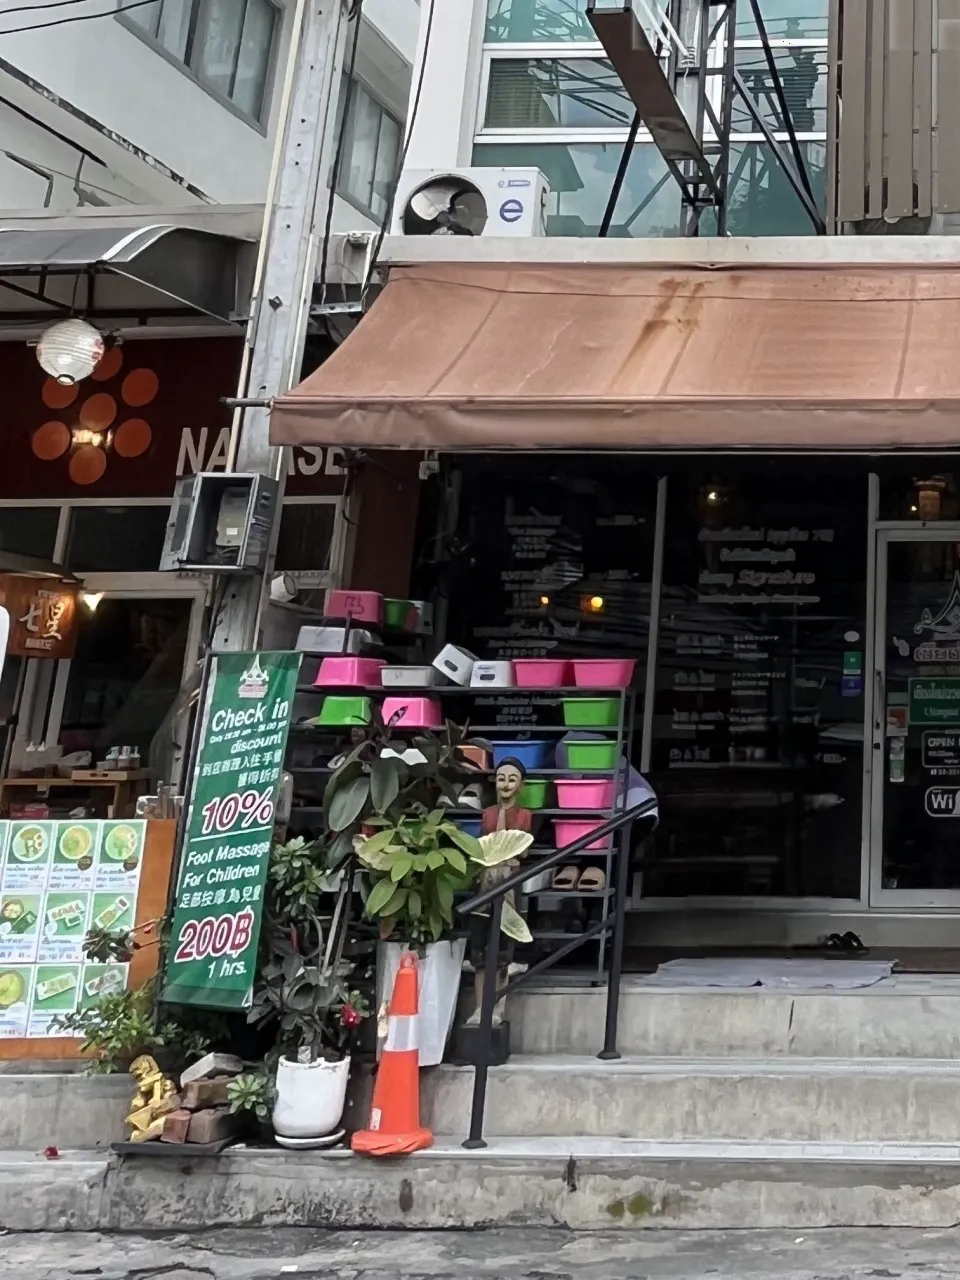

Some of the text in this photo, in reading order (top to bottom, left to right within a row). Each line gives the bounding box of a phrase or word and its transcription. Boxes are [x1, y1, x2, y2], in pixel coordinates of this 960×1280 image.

[212, 697, 289, 732] Check in
[230, 732, 282, 754] discount
[202, 785, 274, 834] 10%
[186, 848, 213, 867] Foot
[182, 864, 260, 888] For Children
[208, 959, 247, 979] 1 hrs.
